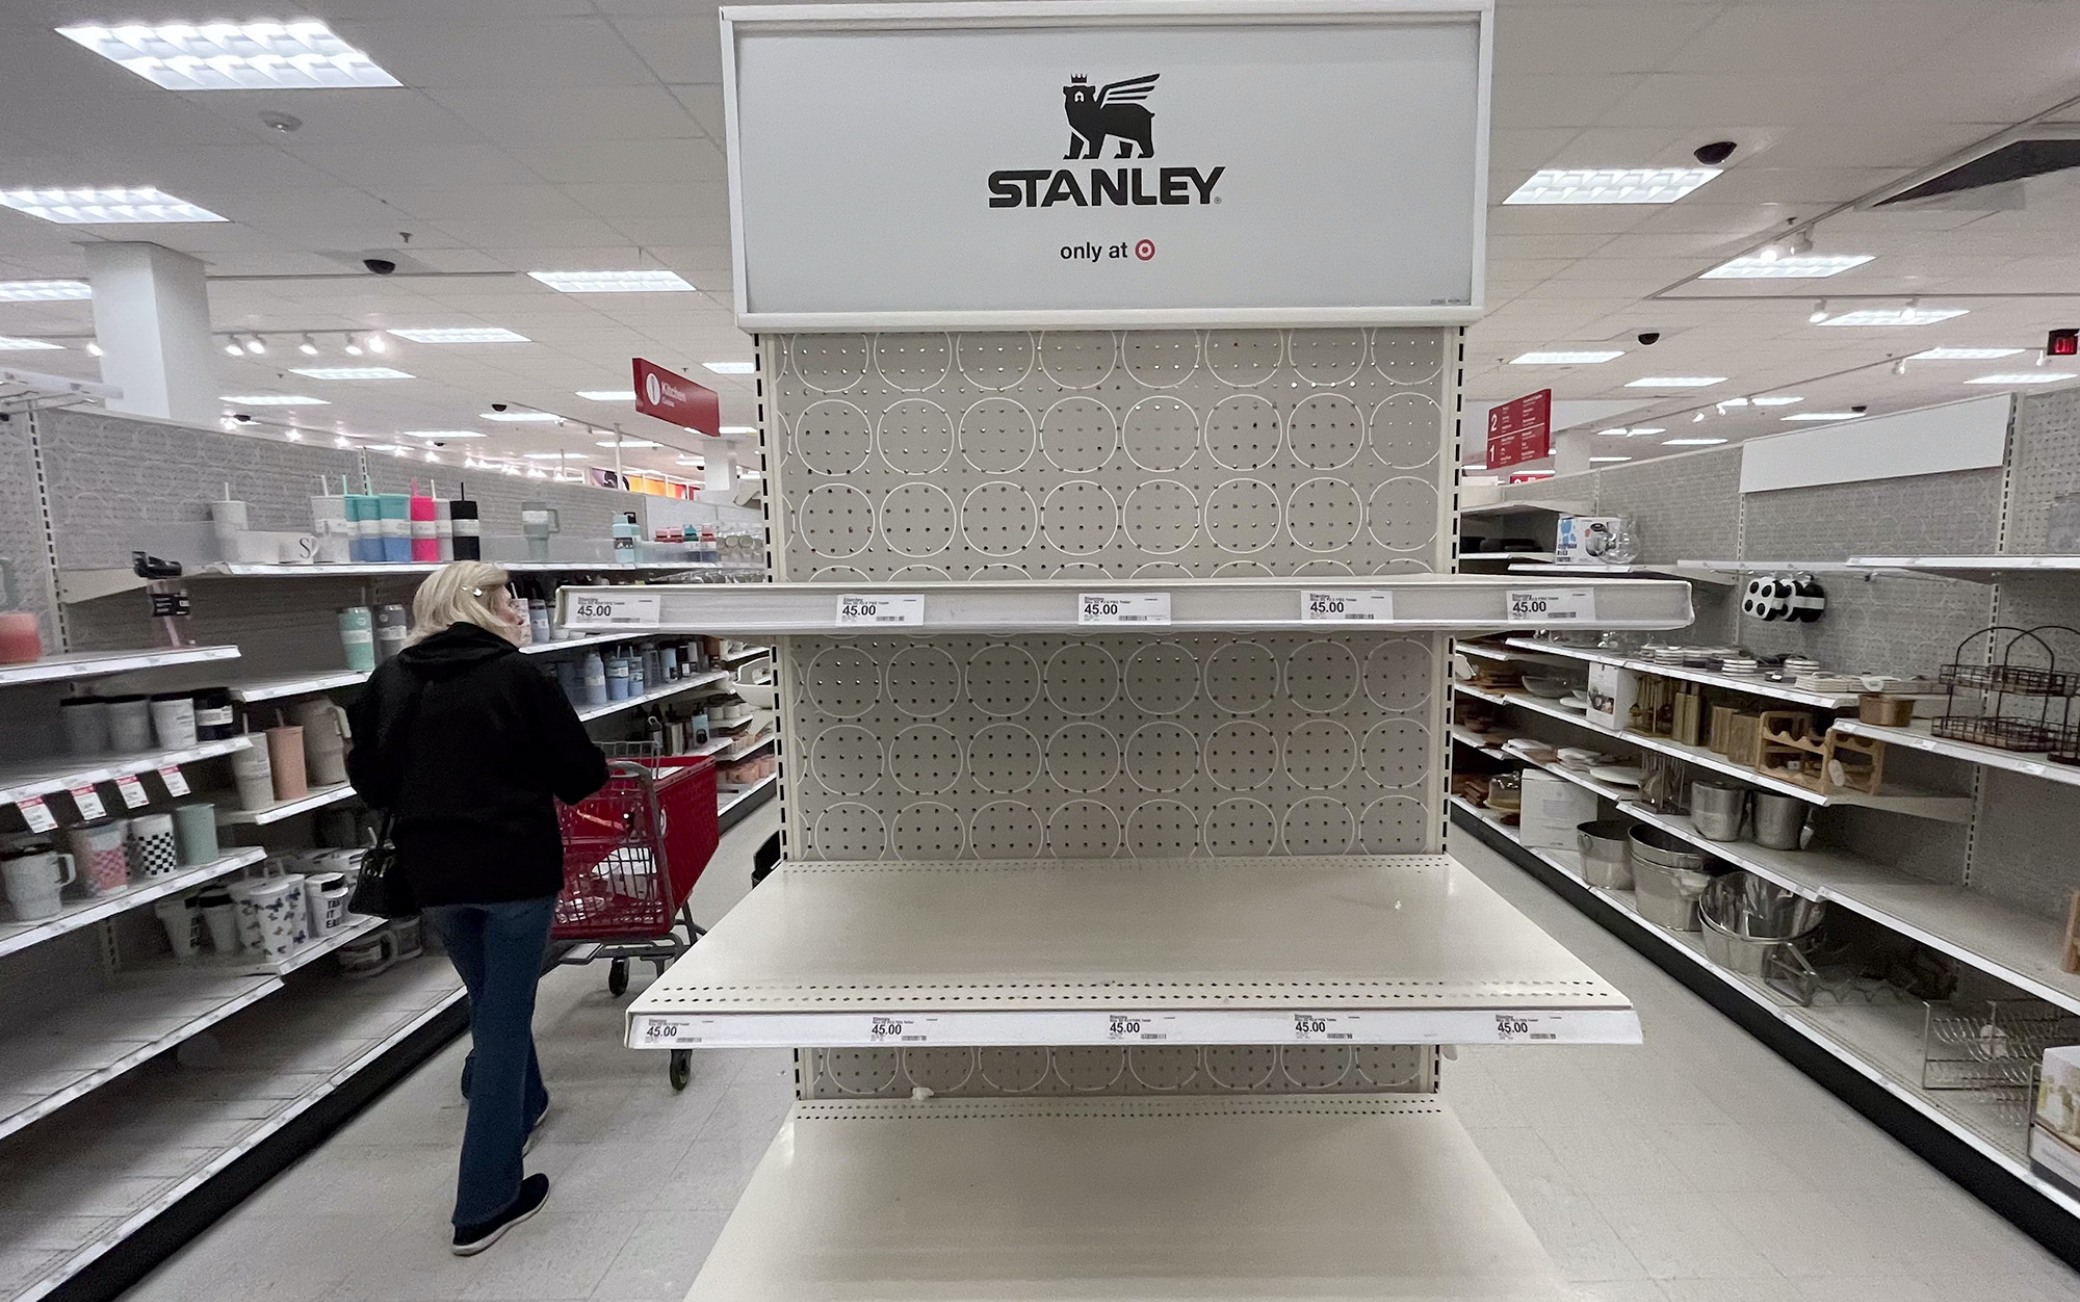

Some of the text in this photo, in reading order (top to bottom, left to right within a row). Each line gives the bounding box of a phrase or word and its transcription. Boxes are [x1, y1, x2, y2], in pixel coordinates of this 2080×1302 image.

[988, 166, 1225, 208] STANLEY
[1060, 242, 1128, 262] only at
[1490, 414, 1498, 432] 2
[1489, 444, 1495, 462] 1
[299, 537, 311, 559] S
[577, 605, 612, 616] 45.00
[842, 605, 876, 616] 45.00
[1084, 604, 1118, 615] 45.00
[1310, 601, 1344, 613] 45.00
[1512, 601, 1547, 613] 45.00
[646, 1026, 677, 1037] 45.00
[871, 1024, 902, 1035] 45.00
[1109, 1022, 1140, 1033] 45.00
[1295, 1021, 1326, 1032] 45.00
[1497, 1022, 1528, 1033] 45.00
